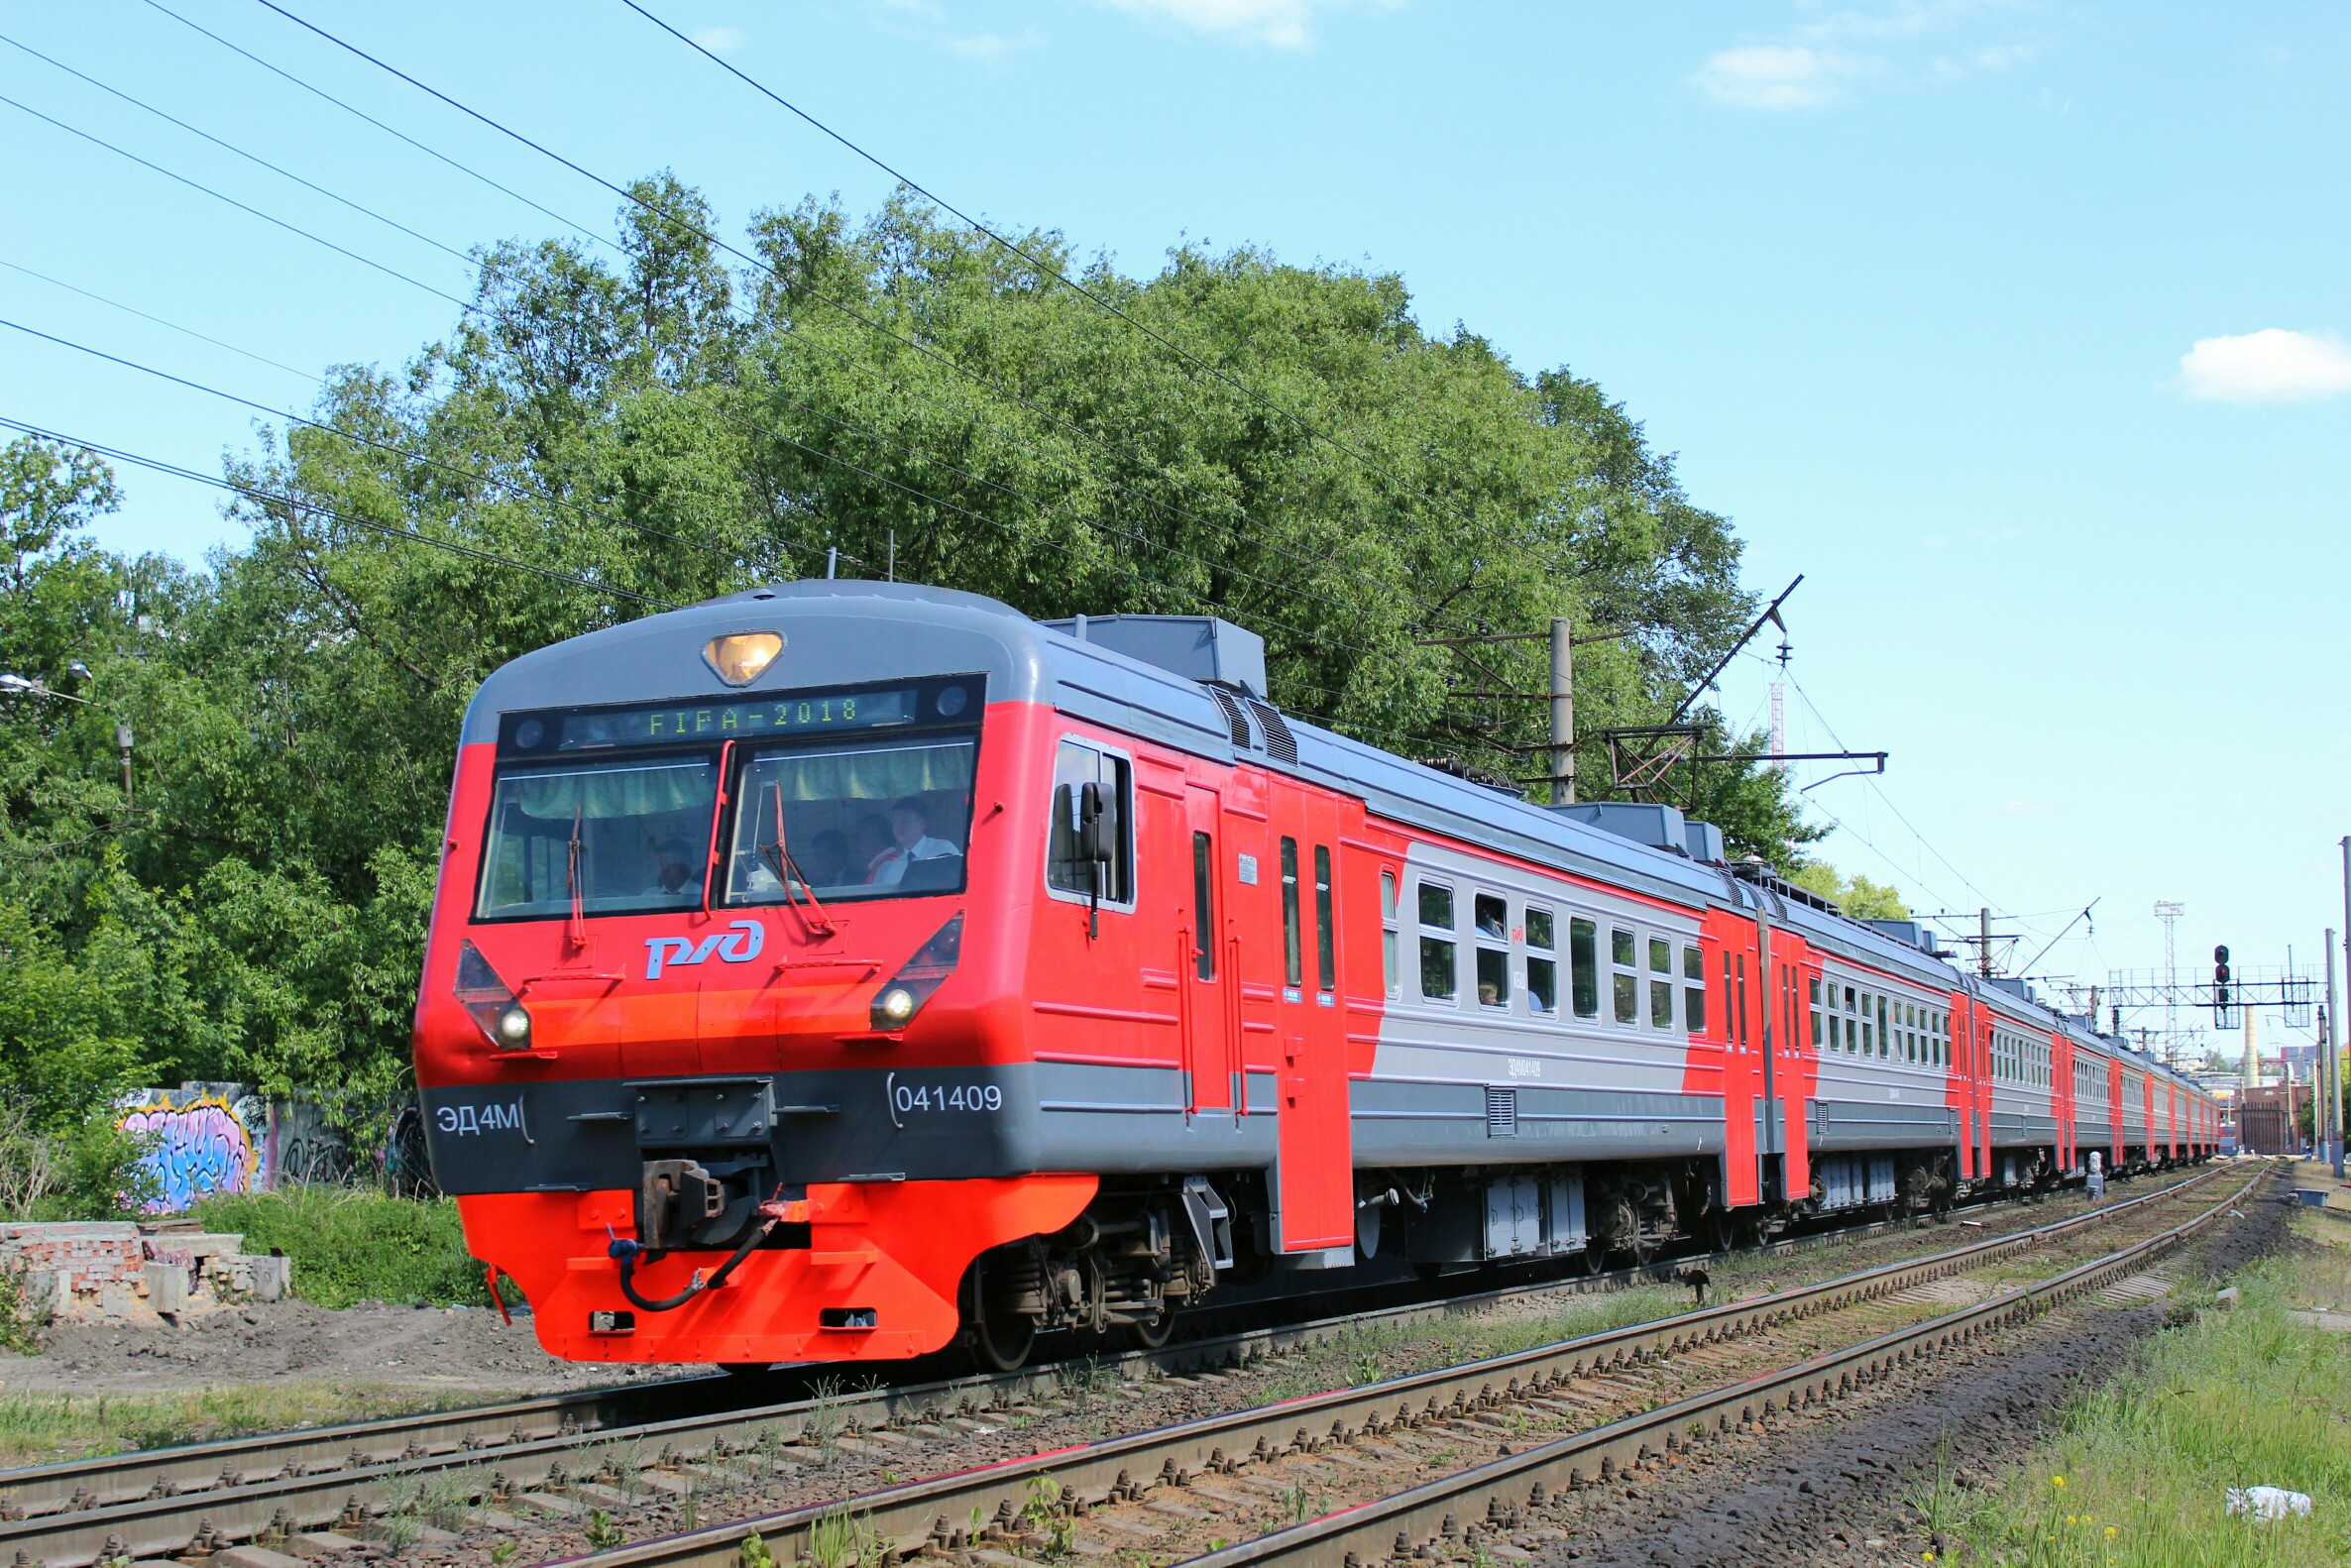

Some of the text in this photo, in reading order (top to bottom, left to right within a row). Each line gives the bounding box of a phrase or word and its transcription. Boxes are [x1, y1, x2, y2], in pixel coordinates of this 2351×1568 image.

[649, 698, 856, 735] FIFA-2018
[895, 1084, 1003, 1112] 041409
[436, 1103, 520, 1137] ЭД4М
